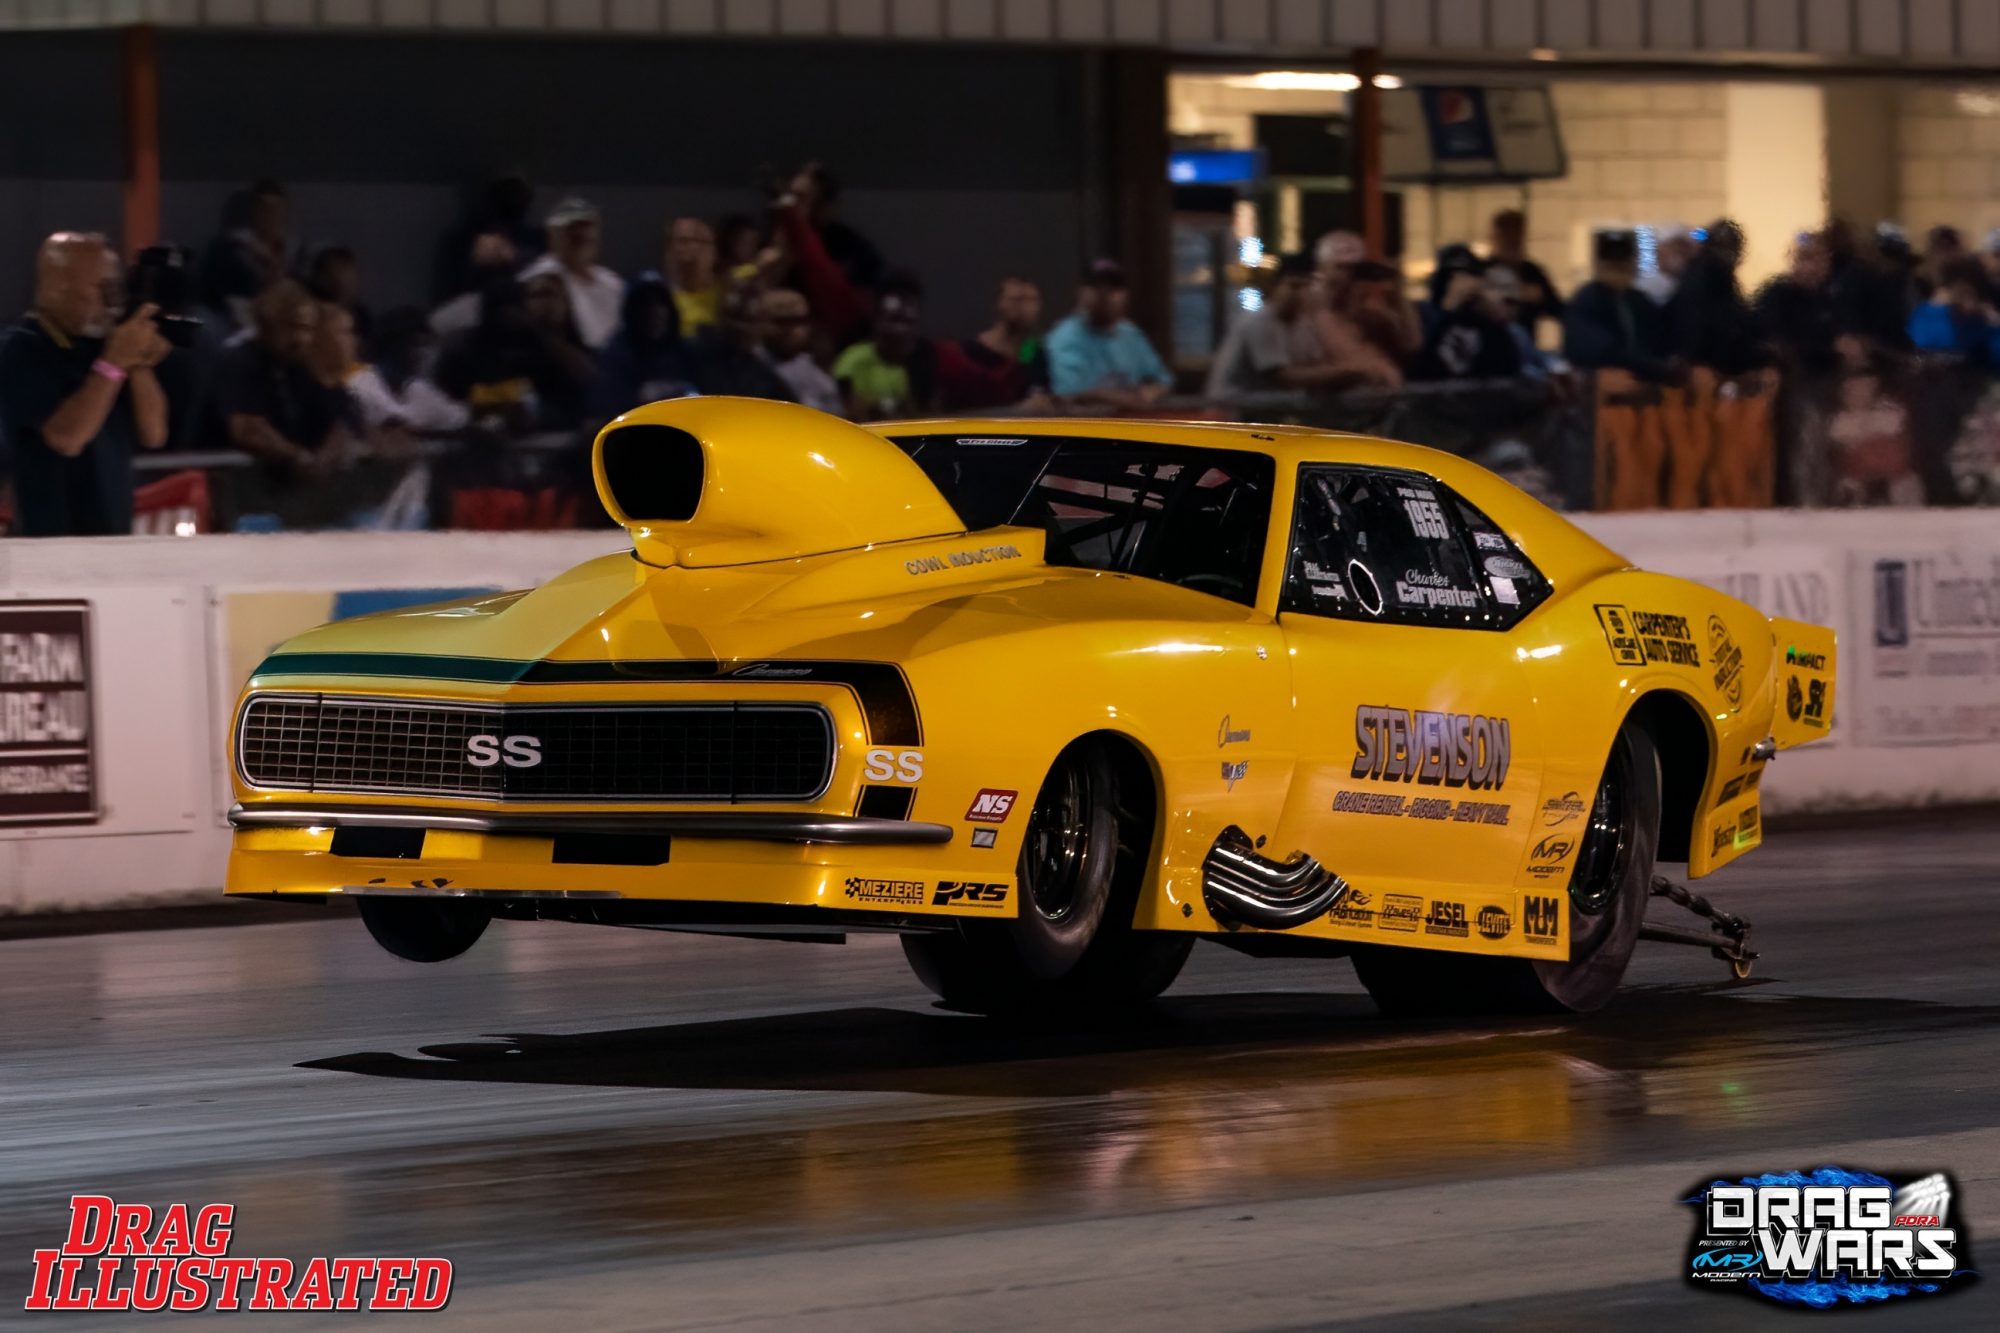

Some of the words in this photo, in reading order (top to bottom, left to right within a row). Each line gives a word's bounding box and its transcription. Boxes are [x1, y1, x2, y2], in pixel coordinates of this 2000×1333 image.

[1403, 499, 1450, 539] 1955
[904, 555, 949, 576] COWL
[948, 545, 1022, 568] INDUCTION
[1405, 568, 1450, 587] Charles
[1395, 580, 1479, 609] Carpenter
[467, 734, 542, 768] SS
[1351, 704, 1511, 791] STEVENSON
[864, 749, 924, 783] SS
[972, 794, 1013, 814] NS
[859, 879, 924, 899] MEZIERE
[1425, 900, 1469, 929] JESEL
